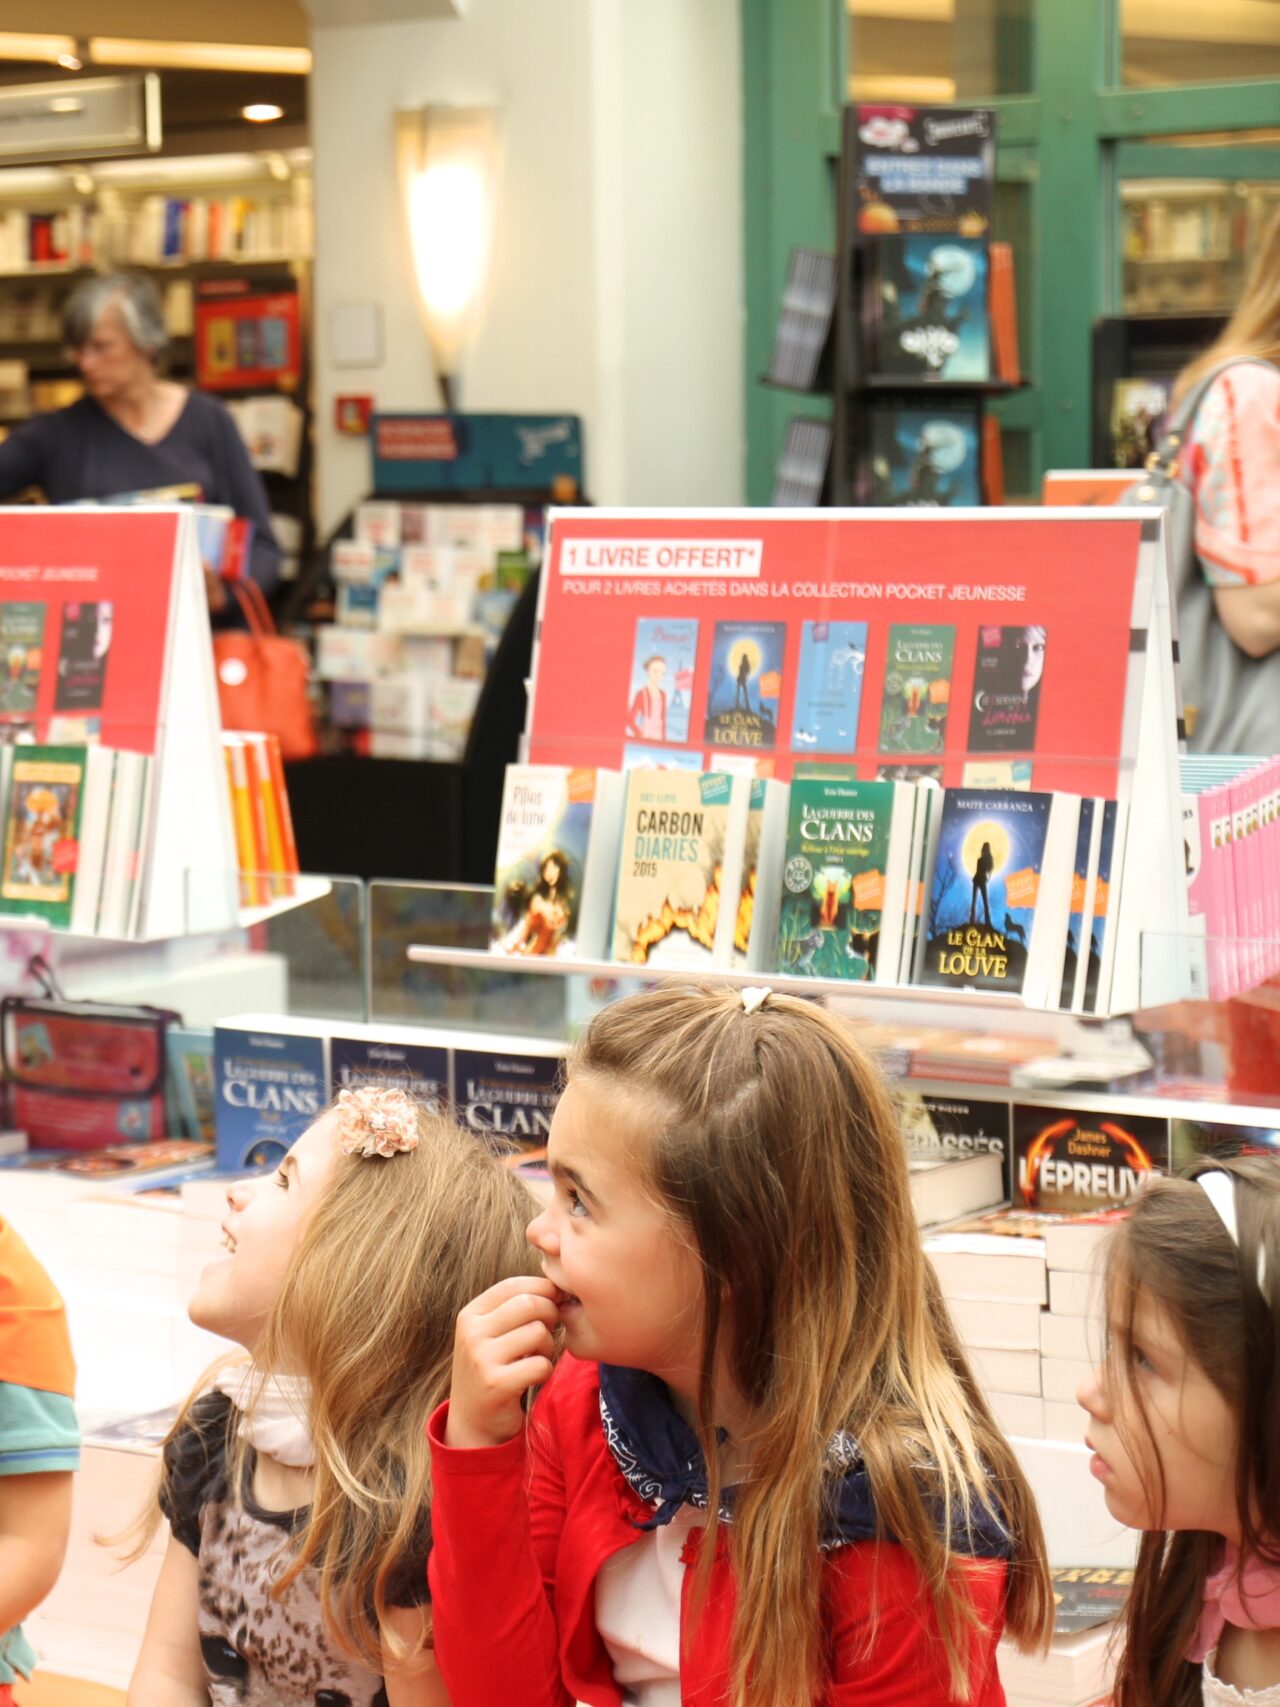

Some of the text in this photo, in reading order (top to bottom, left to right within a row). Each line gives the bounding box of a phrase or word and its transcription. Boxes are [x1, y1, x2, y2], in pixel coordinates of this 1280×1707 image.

[569, 547, 577, 566] 1
[585, 547, 649, 567] LIVRE
[562, 579, 601, 595] POUR
[603, 580, 613, 595] 2
[615, 580, 661, 596] LIVRES
[729, 581, 769, 597] DANS
[771, 582, 789, 597] LA
[792, 582, 882, 598] COLLECTION
[886, 583, 946, 600] POCKET
[948, 584, 1026, 601] JEUNESSE
[714, 728, 763, 746] LOUVE
[856, 810, 875, 821] DES
[985, 802, 1033, 813] CARRANZA
[637, 810, 704, 836] CARBON
[800, 819, 874, 842] CLANS
[635, 836, 699, 862] DIARIES
[633, 861, 657, 878] 2015
[948, 928, 1006, 951] LE CLAN
[938, 952, 1008, 979] LOUVE
[222, 1078, 318, 1115] CLANS
[466, 1100, 554, 1135] CLAN
[1074, 1128, 1107, 1144] James
[1068, 1141, 1112, 1158] Dashner
[1019, 1151, 1163, 1200] L'ÉPREUV
